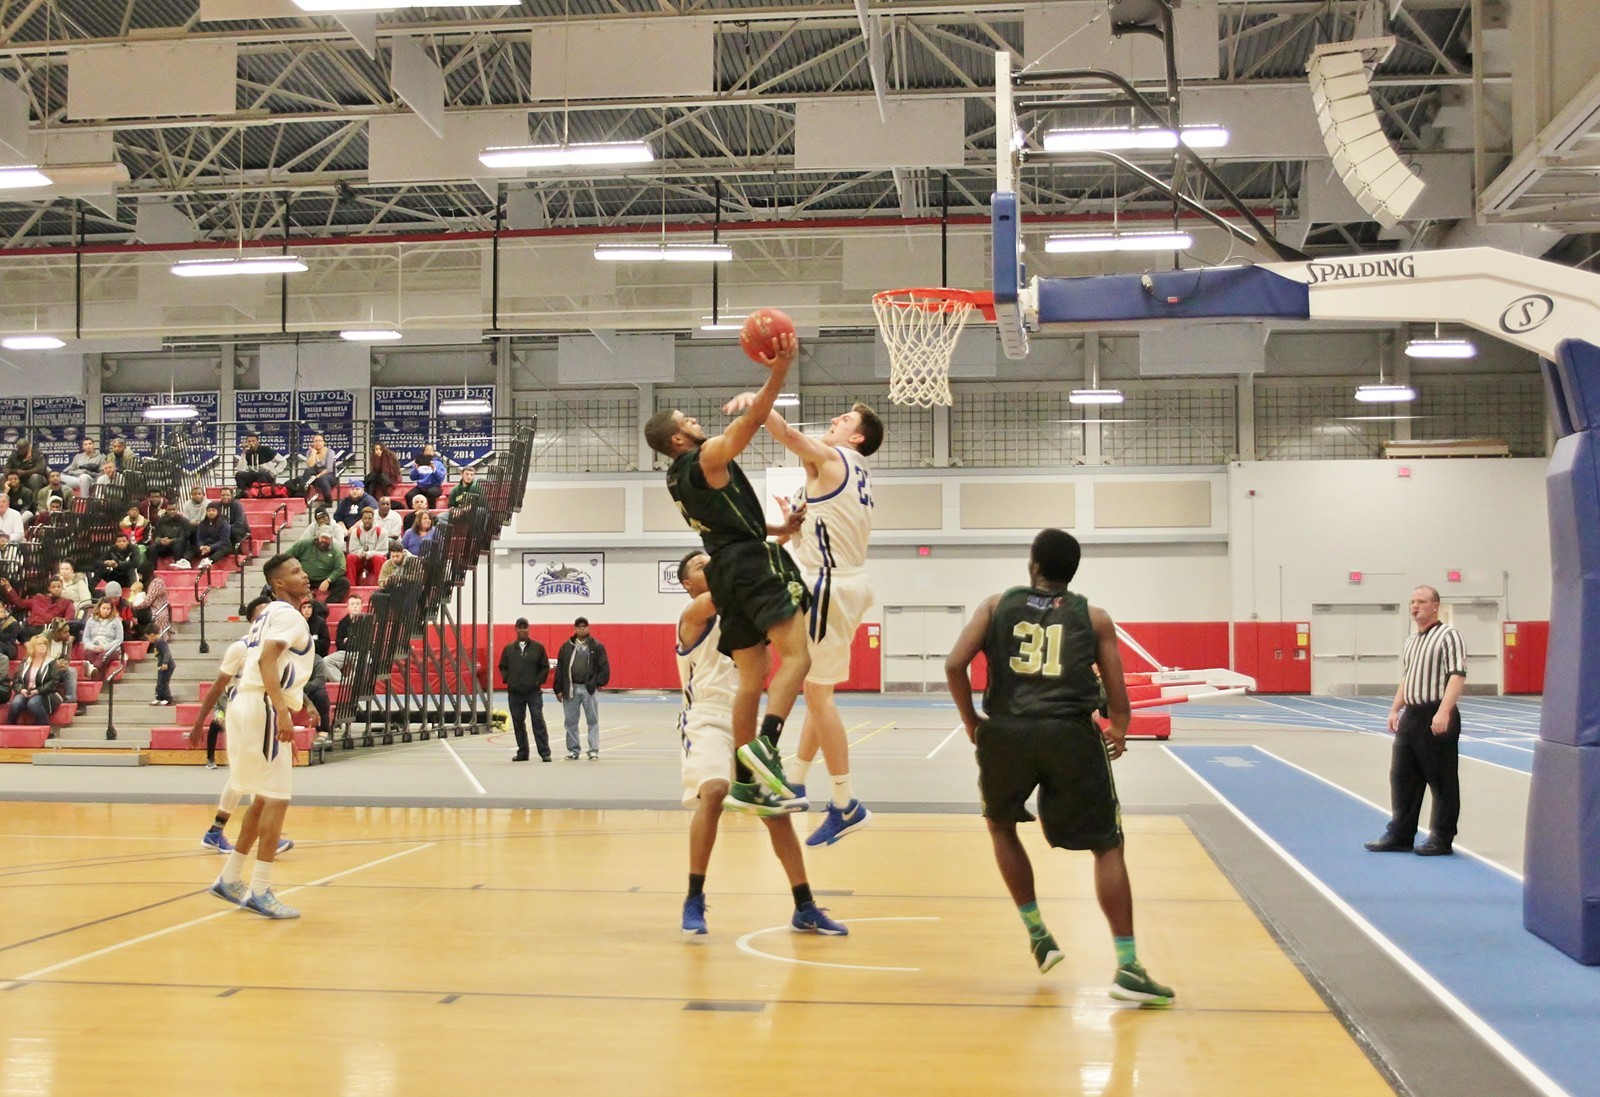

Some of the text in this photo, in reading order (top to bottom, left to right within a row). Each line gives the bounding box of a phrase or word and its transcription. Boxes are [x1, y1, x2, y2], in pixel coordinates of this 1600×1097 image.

[1306, 255, 1415, 284] SPALDING
[165, 394, 216, 405] SUFFOLK
[238, 392, 289, 403] SUFFOLK
[300, 391, 352, 402] SUFFOLK
[376, 390, 428, 400] SUFFOLK
[438, 389, 491, 399] SUFFOLK
[33, 398, 85, 408] SUFFOLK
[104, 395, 157, 405] SUFFOLK
[454, 450, 475, 459] 2014
[536, 583, 590, 598] SHARKS
[1009, 621, 1063, 676] 31
